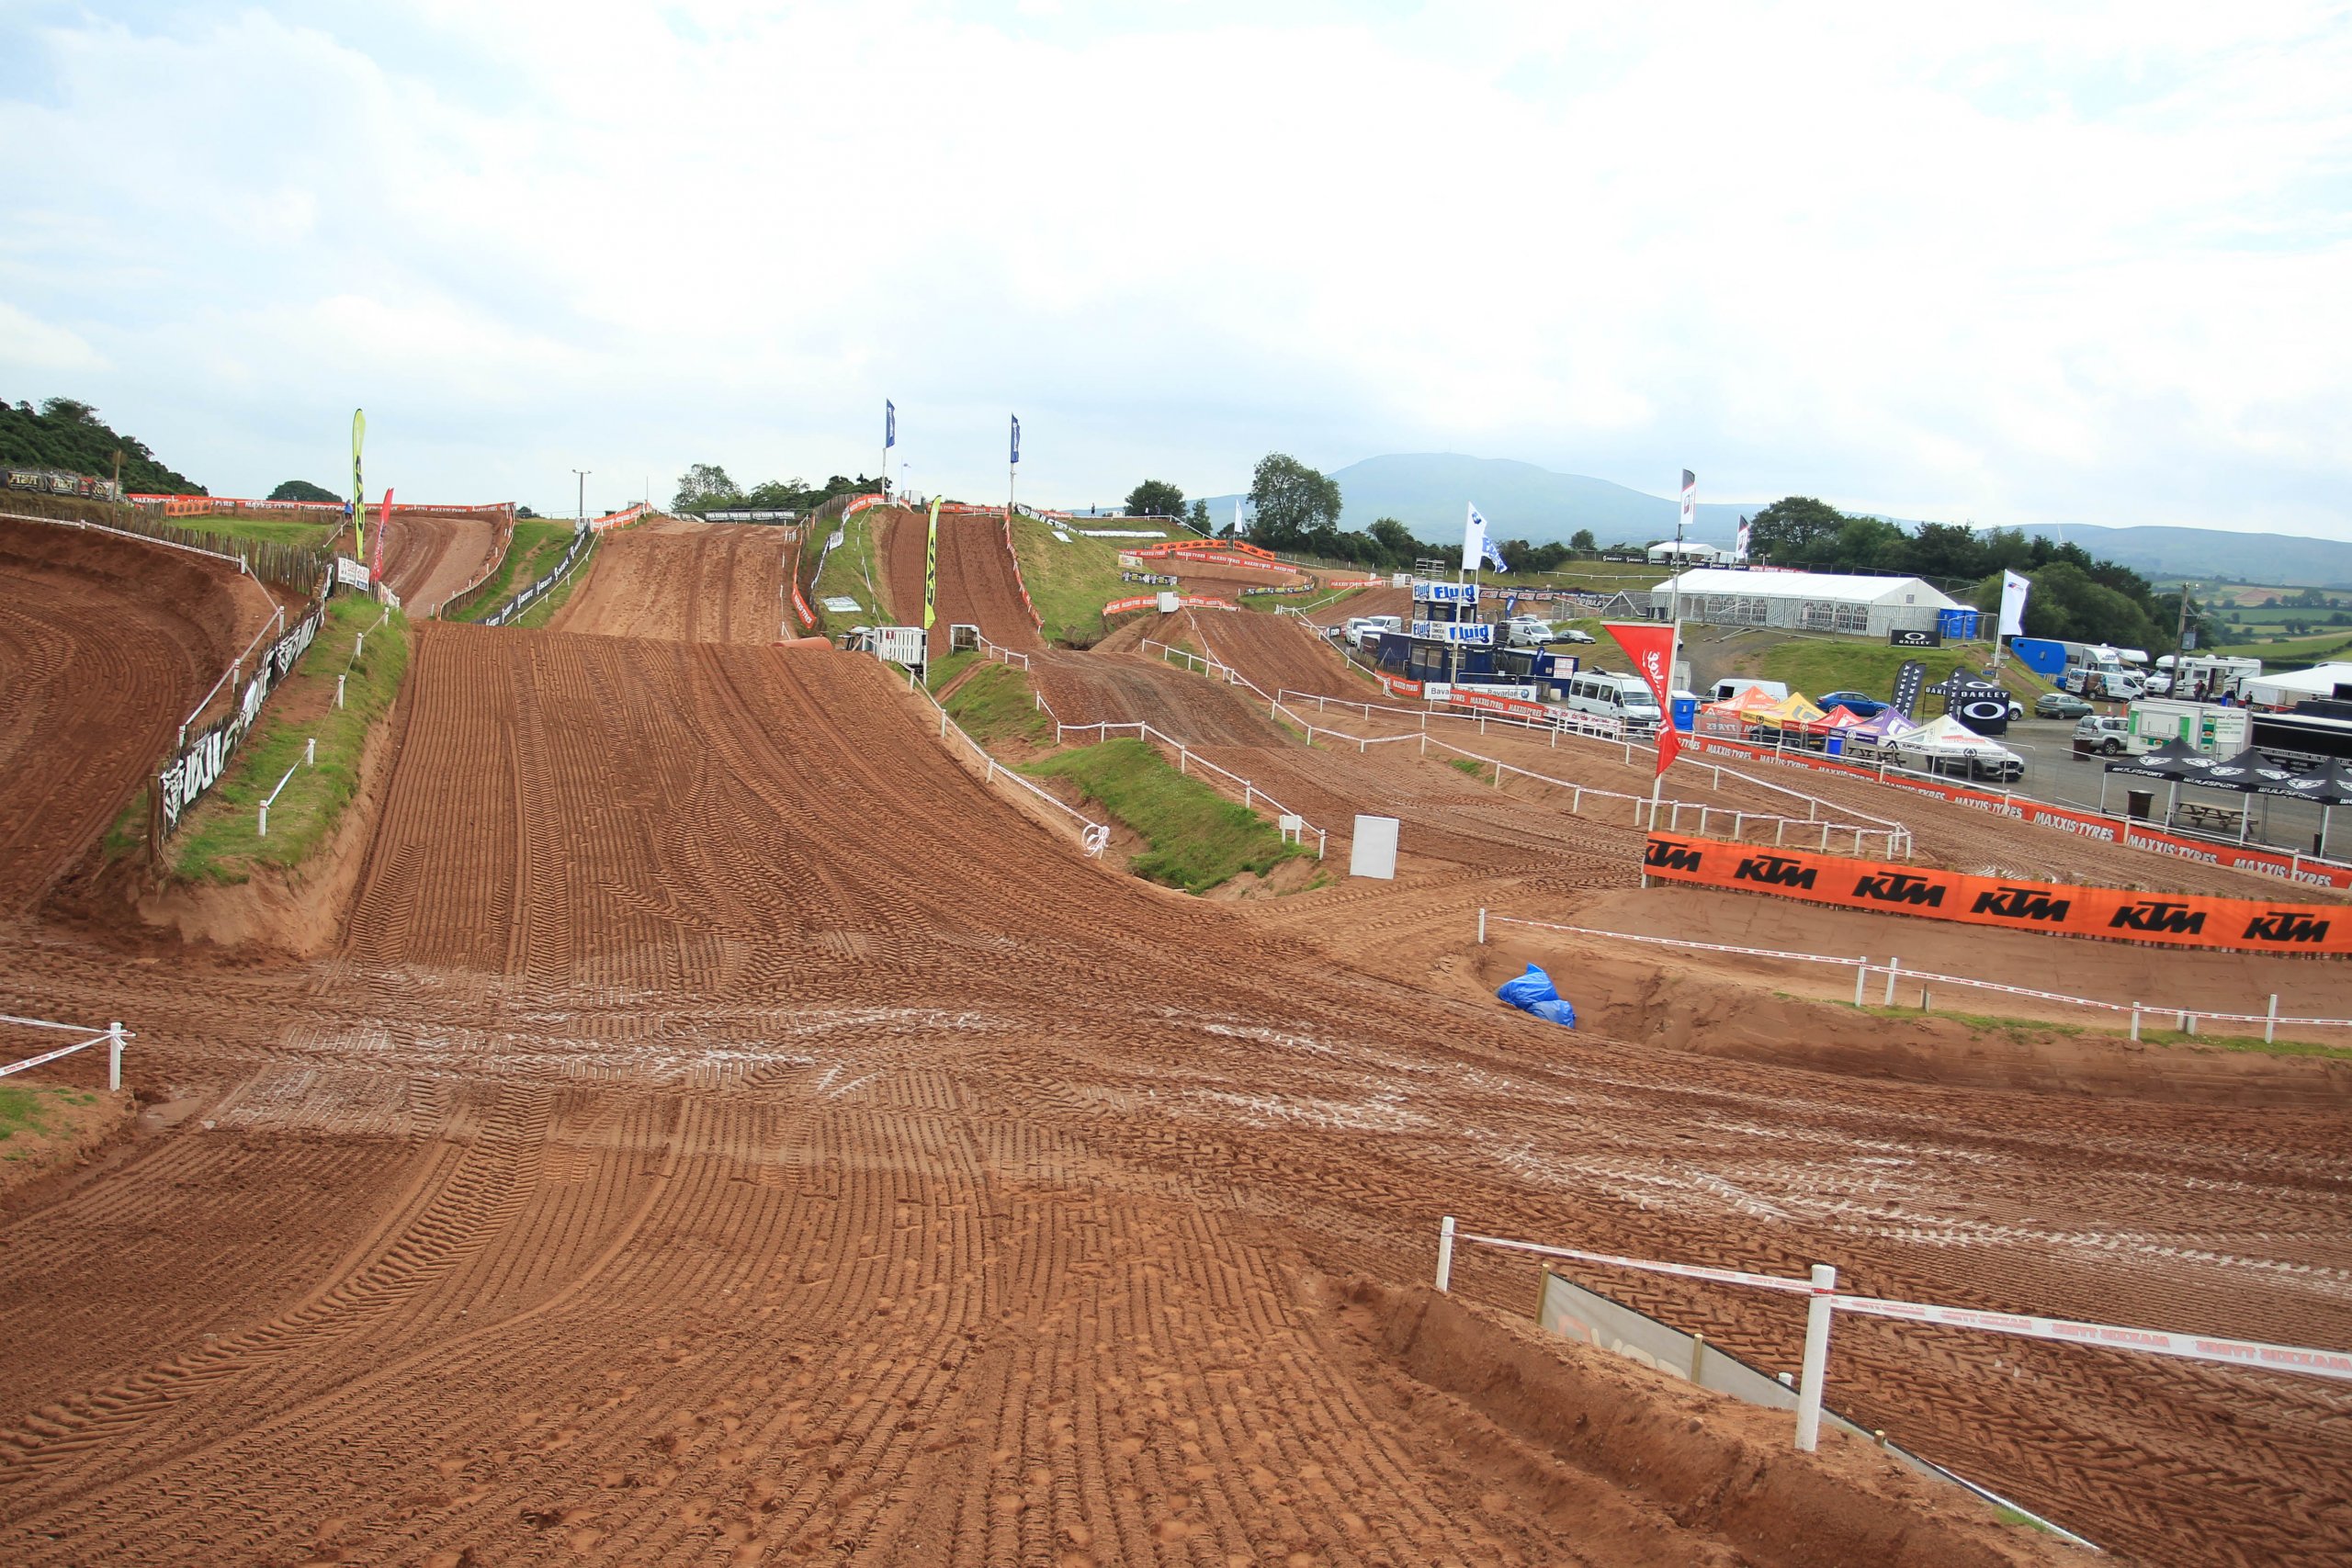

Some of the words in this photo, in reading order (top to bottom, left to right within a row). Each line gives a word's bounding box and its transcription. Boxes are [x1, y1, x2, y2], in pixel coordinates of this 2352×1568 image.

[1896, 665, 1909, 704] OAKLEY
[1905, 669, 1920, 708] OAKLEY
[1706, 744, 1731, 756] MAXXIS
[1731, 750, 1752, 760] TYRES
[2032, 811, 2076, 833] MAXXIS
[2078, 820, 2114, 842] TYRES
[1645, 839, 1702, 873] TM
[2128, 834, 2175, 855] MAXXIS
[1734, 854, 1818, 889] KTM
[2233, 858, 2286, 878] MAXXIS
[1851, 871, 1946, 908] KTM
[1970, 886, 2071, 922] KTM
[2108, 900, 2207, 935] KTM
[2241, 911, 2330, 942] KTM
